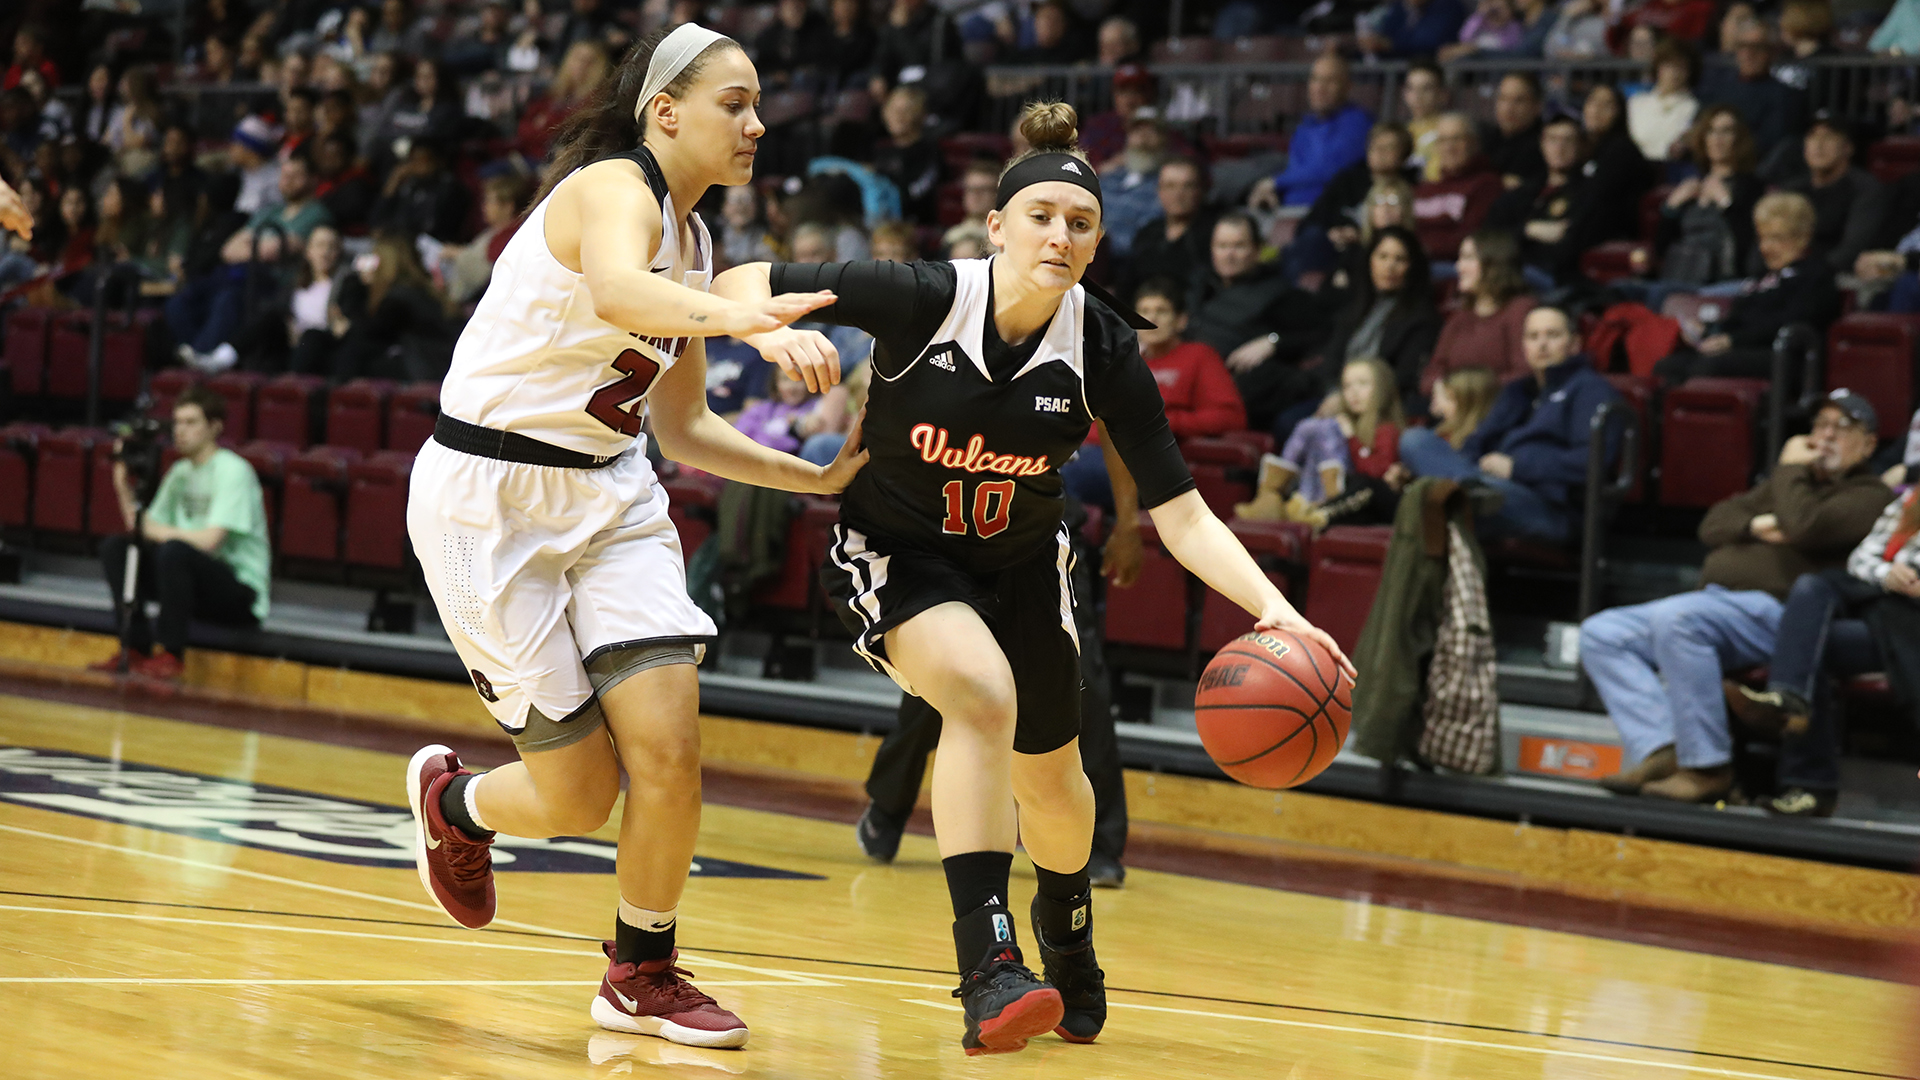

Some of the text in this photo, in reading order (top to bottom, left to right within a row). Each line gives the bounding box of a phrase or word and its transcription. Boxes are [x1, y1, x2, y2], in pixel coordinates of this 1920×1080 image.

[929, 357, 956, 372] adidas
[1034, 396, 1071, 413] PSAC
[911, 423, 1051, 476] Vulcans
[942, 479, 1016, 540] 10
